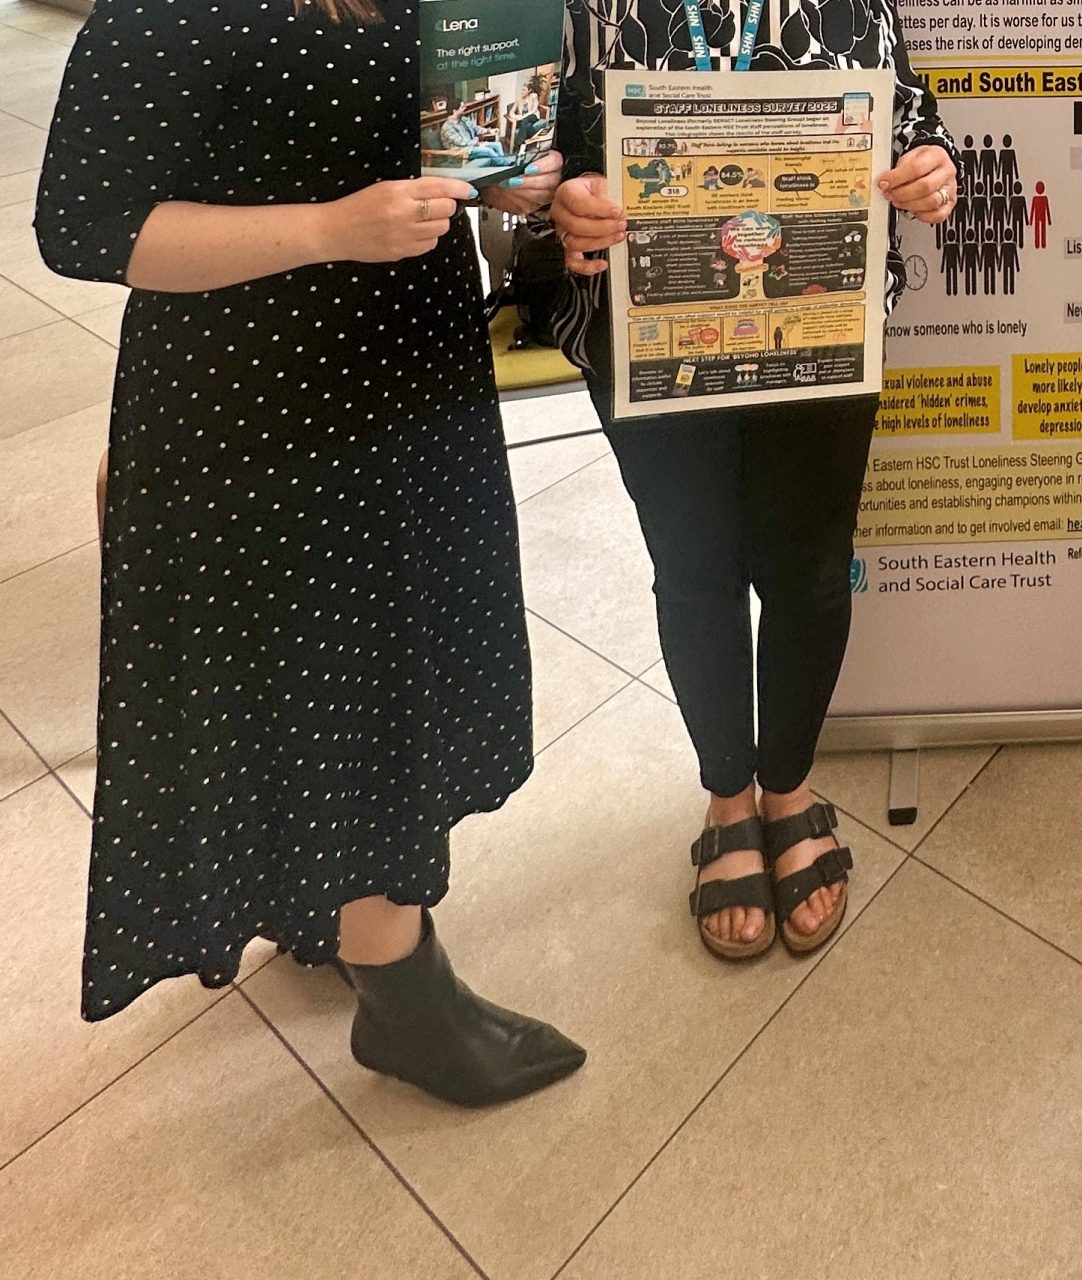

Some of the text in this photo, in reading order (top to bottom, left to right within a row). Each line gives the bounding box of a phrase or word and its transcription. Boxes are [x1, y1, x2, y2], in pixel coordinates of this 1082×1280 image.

[687, 5, 700, 26] NHS
[748, 2, 761, 24] NHS
[443, 19, 478, 32] Lena
[437, 48, 456, 58] The
[458, 44, 480, 56] right
[693, 36, 706, 57] NHS
[742, 32, 754, 55] NHS
[451, 60, 468, 69] the
[470, 55, 492, 67] right
[936, 72, 972, 94] and
[979, 71, 1035, 93] South
[654, 101, 838, 114] STAFF LONELINESS SURVEY 2025
[884, 319, 1028, 338] know someone who is lonely
[875, 523, 932, 537] information
[934, 521, 954, 535] and
[957, 521, 968, 534] to
[969, 520, 986, 537] get
[988, 519, 1031, 533] involved
[1033, 517, 1064, 532] email:
[878, 550, 1056, 571] South Eastern Health
[878, 574, 1052, 593] and Social Care Trust
